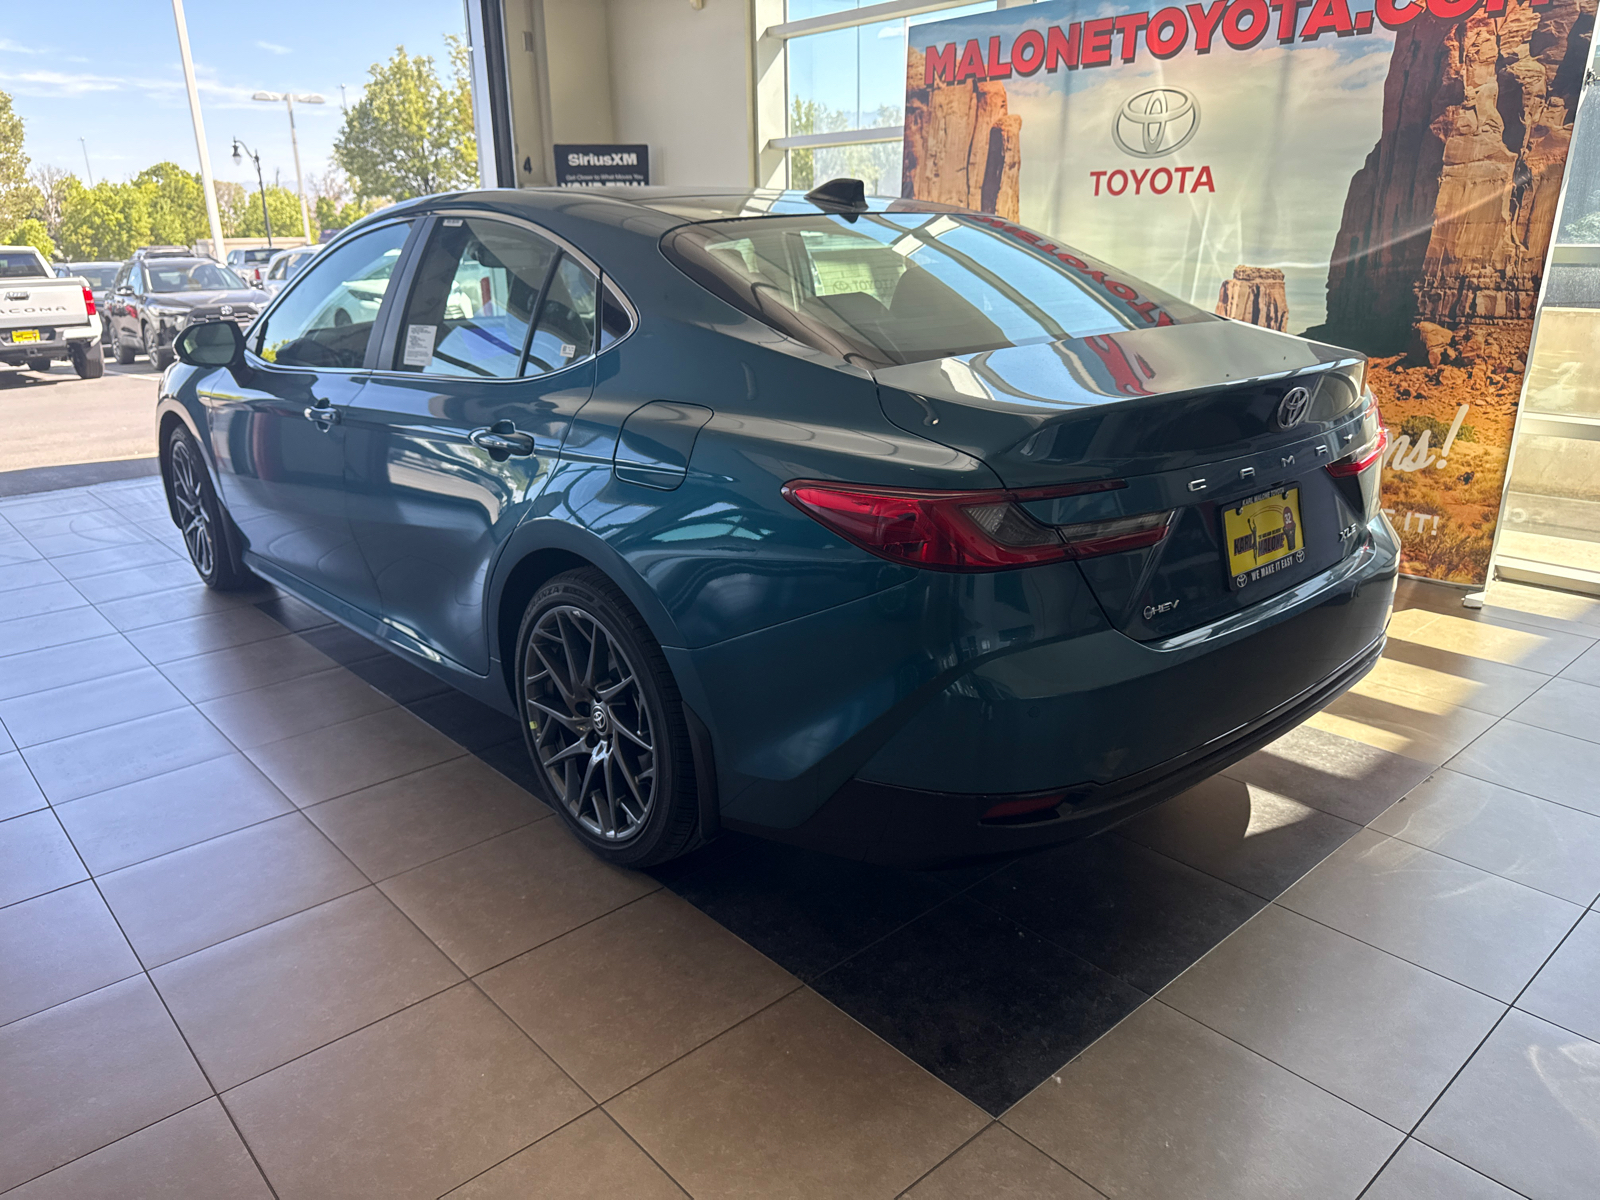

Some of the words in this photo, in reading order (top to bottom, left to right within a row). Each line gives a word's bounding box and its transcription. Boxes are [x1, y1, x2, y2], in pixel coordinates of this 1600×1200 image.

[925, 0, 1550, 85] MALONETOYOTA.C
[523, 156, 533, 174] 4
[567, 153, 638, 167] SiriusXM
[1090, 164, 1216, 197] TOYOTA
[1187, 433, 1354, 492] CAMRY
[1284, 512, 1292, 525] 32
[1403, 511, 1440, 536] IT!
[1338, 522, 1357, 542] XLE
[1250, 569, 1260, 581] WE
[1260, 563, 1275, 578] MAKE
[1275, 561, 1281, 572] IT
[1281, 556, 1293, 569] EASY
